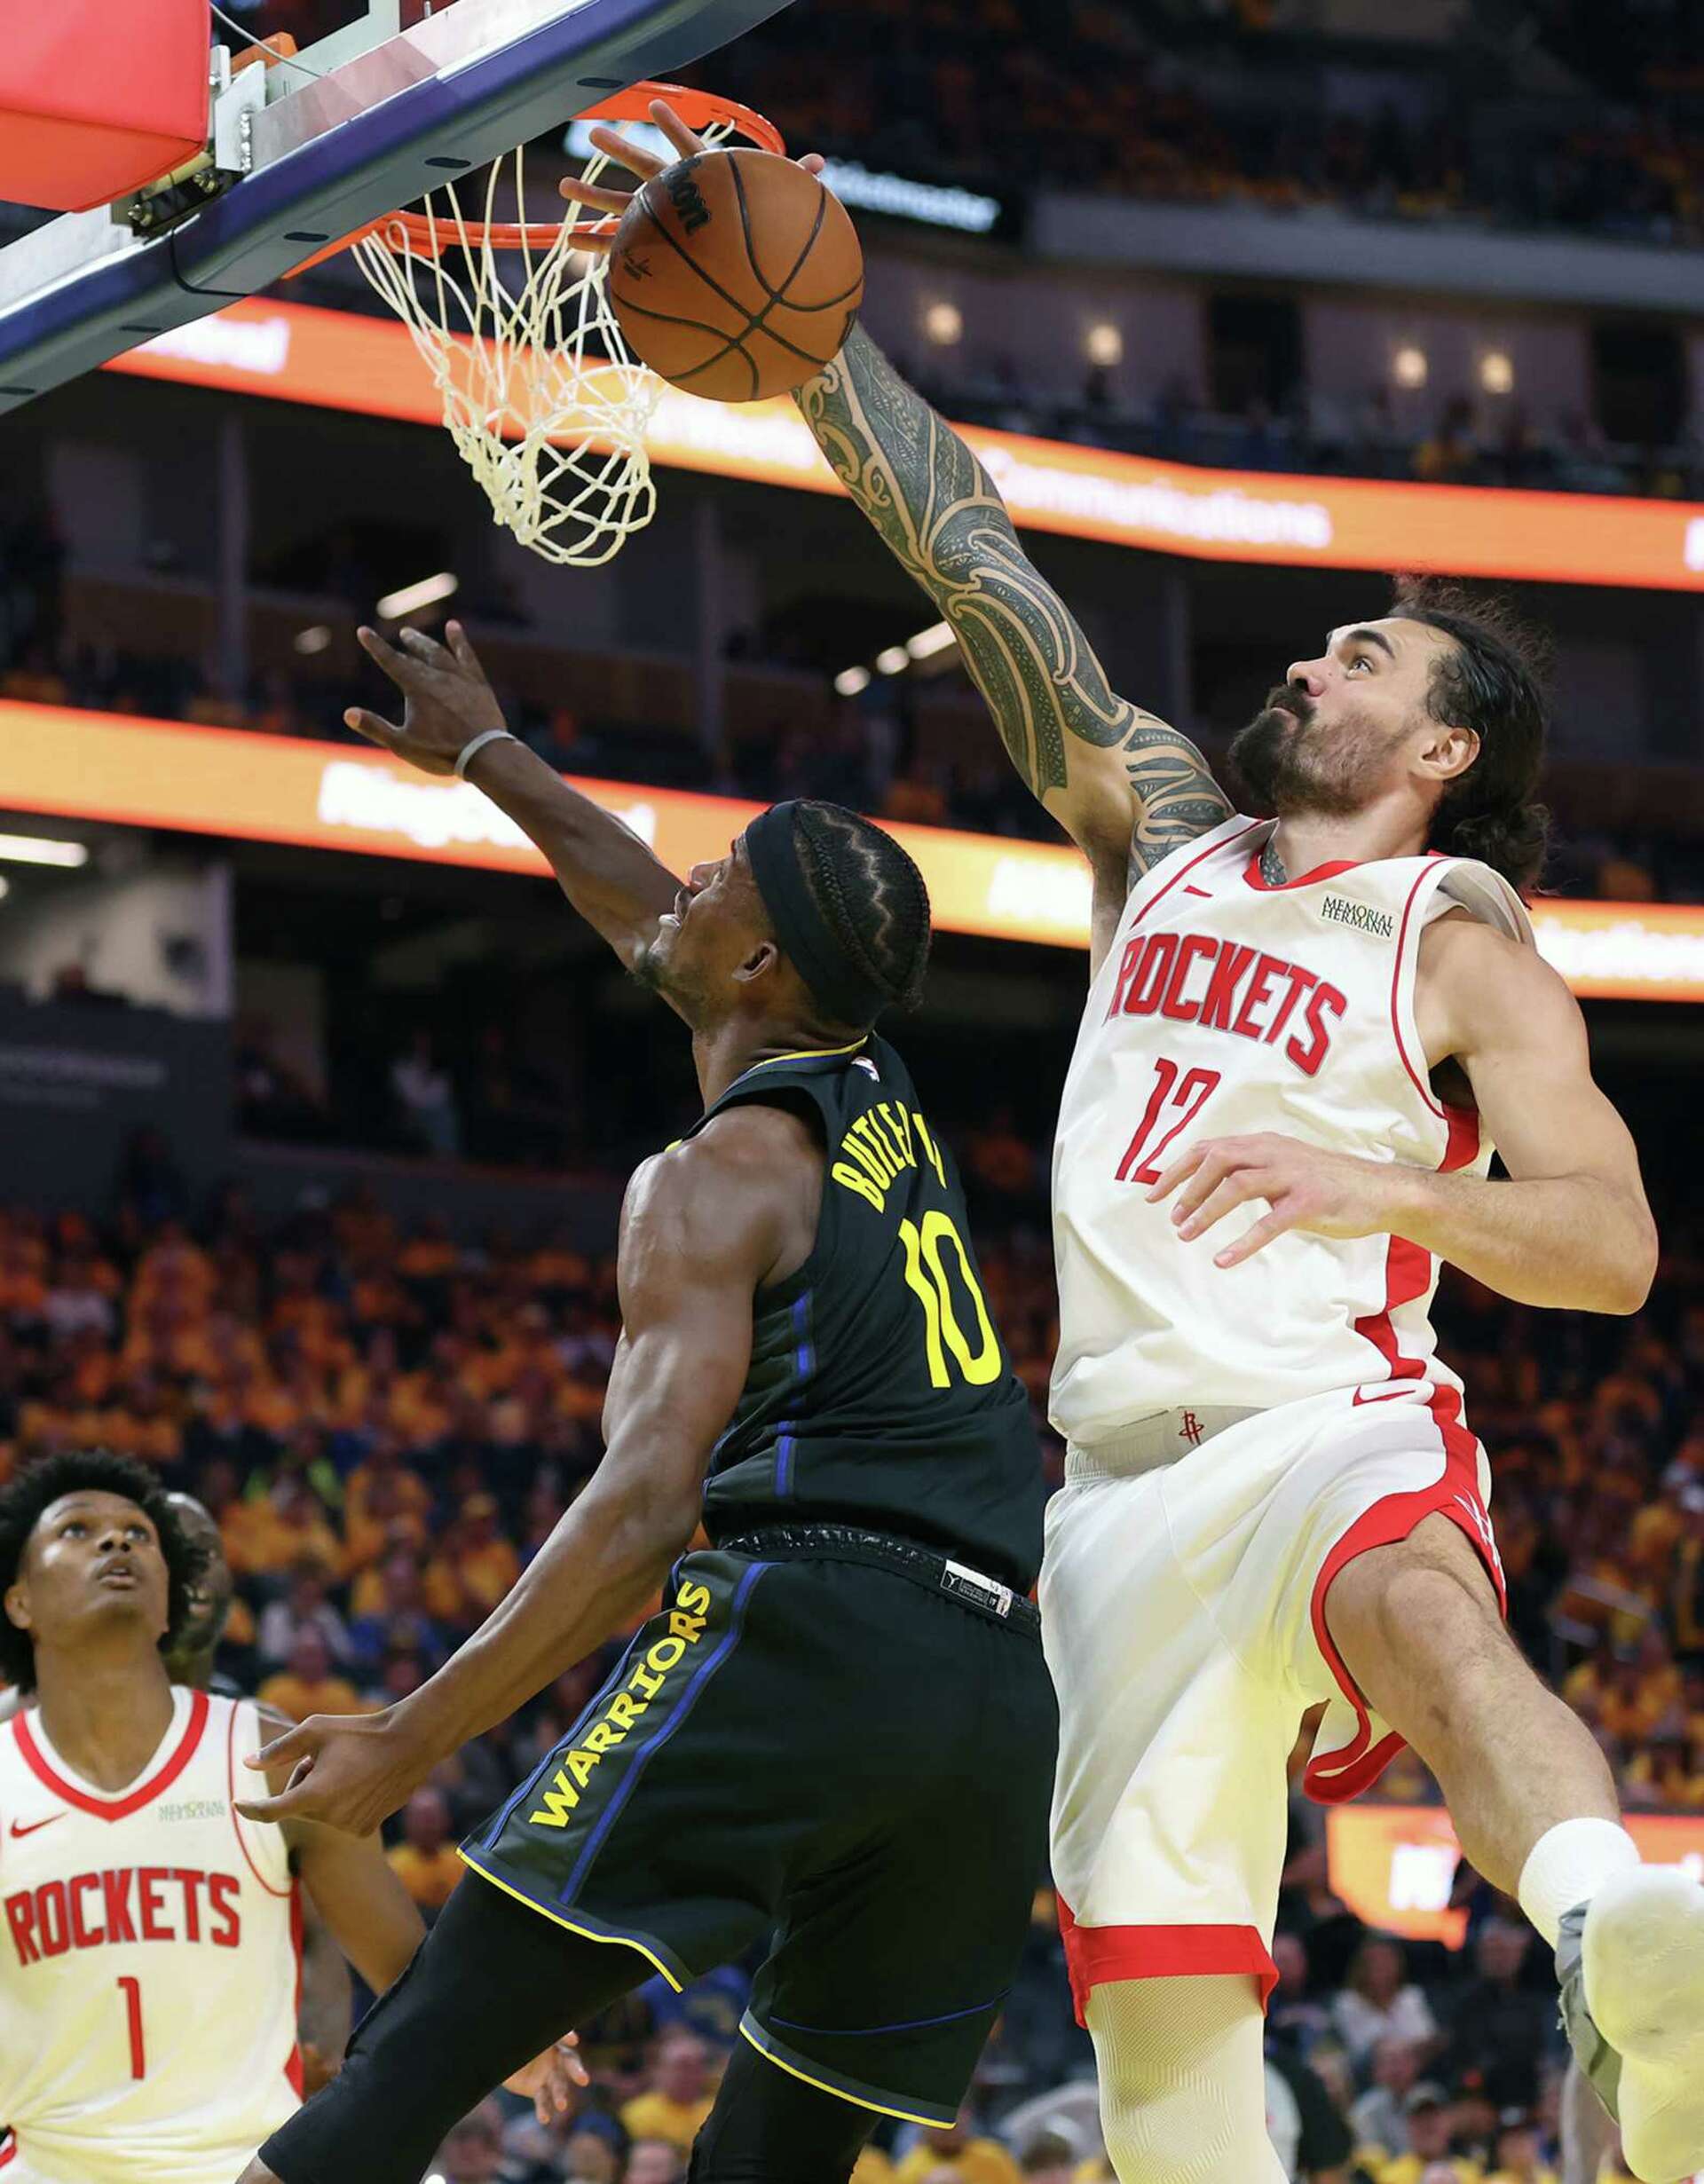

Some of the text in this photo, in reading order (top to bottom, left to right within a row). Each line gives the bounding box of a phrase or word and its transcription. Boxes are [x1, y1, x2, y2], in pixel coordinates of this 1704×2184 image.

[1321, 906, 1392, 937] HERMANN
[1323, 895, 1393, 928] MEMORIAL
[1109, 933, 1347, 1076] ROCKETS
[1115, 1058, 1220, 1185] 12
[898, 1210, 1001, 1388] 10
[529, 1580, 711, 1828] WARRIORS
[4, 1866, 241, 1967] ROCKETS
[117, 1975, 146, 2080] 1
